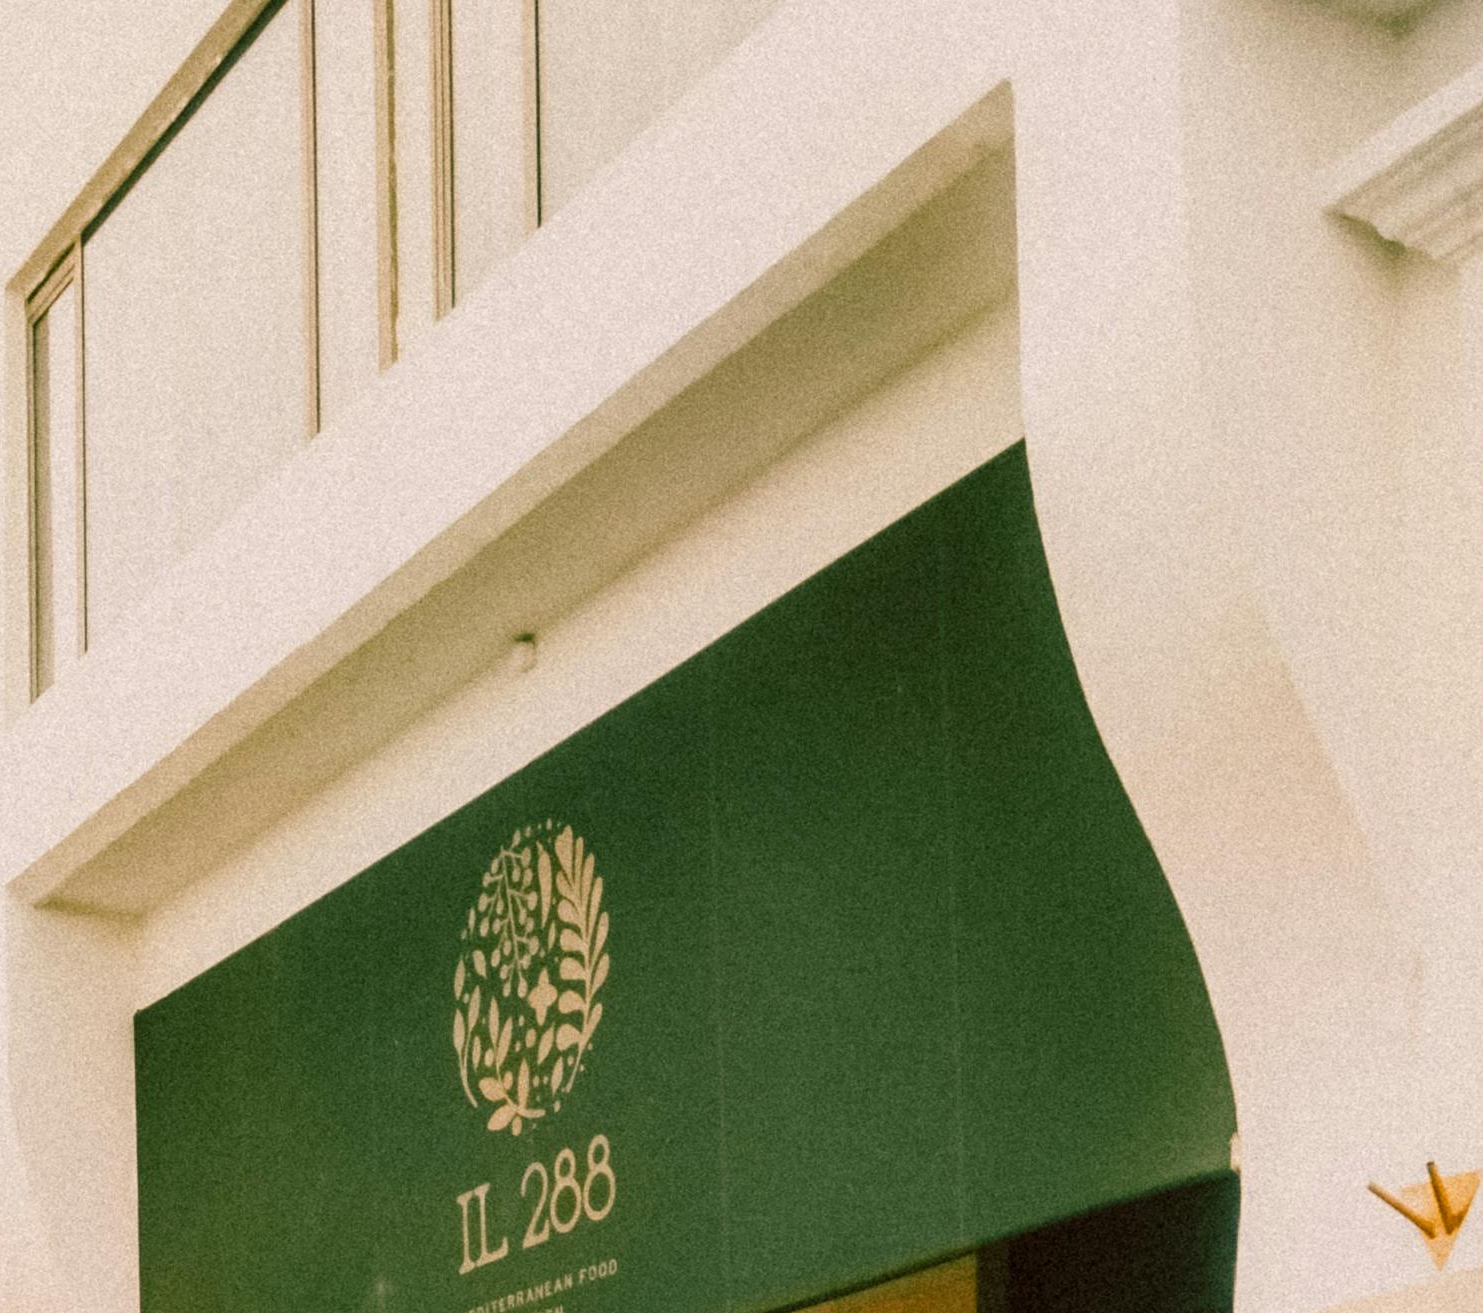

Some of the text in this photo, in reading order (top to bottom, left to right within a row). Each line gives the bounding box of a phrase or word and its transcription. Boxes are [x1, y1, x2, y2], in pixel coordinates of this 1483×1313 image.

[456, 1133, 617, 1276] IL 288
[578, 1258, 619, 1285] FOOD
